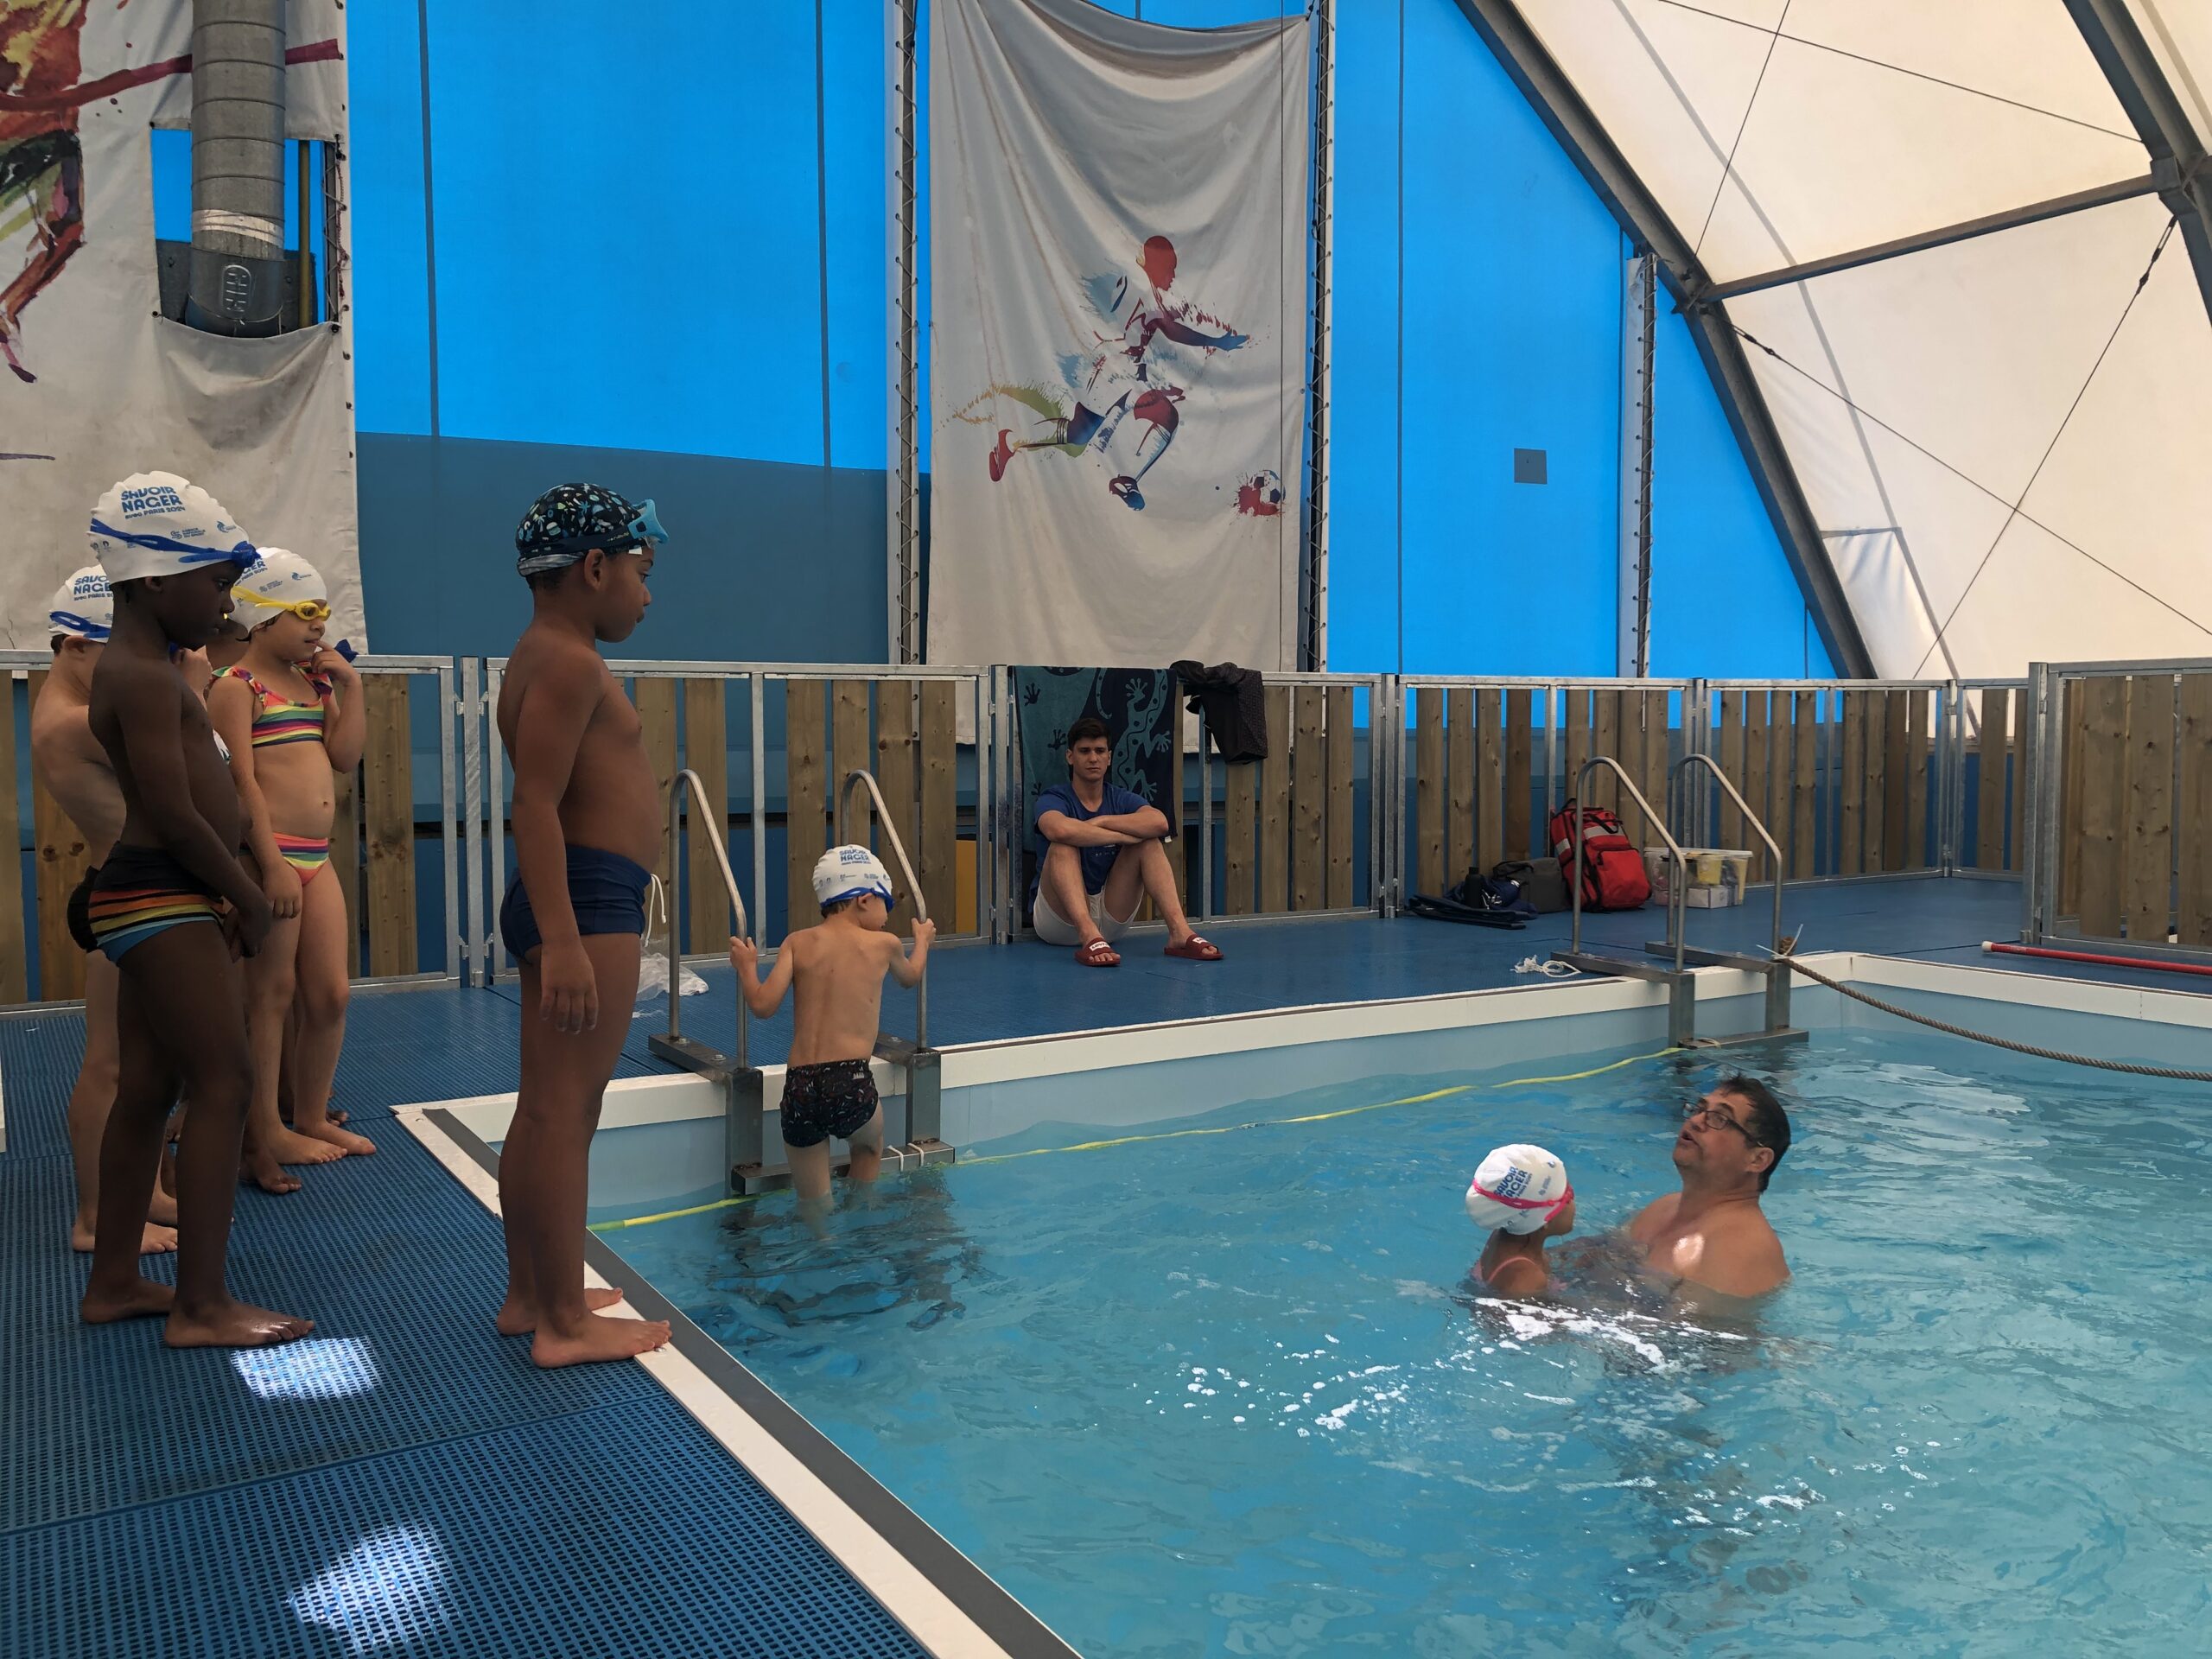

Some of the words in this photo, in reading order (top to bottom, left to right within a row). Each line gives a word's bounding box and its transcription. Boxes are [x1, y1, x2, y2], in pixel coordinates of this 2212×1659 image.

[121, 486, 176, 500] SAVOIR
[122, 495, 182, 512] NAGER
[73, 582, 111, 594] NAGE
